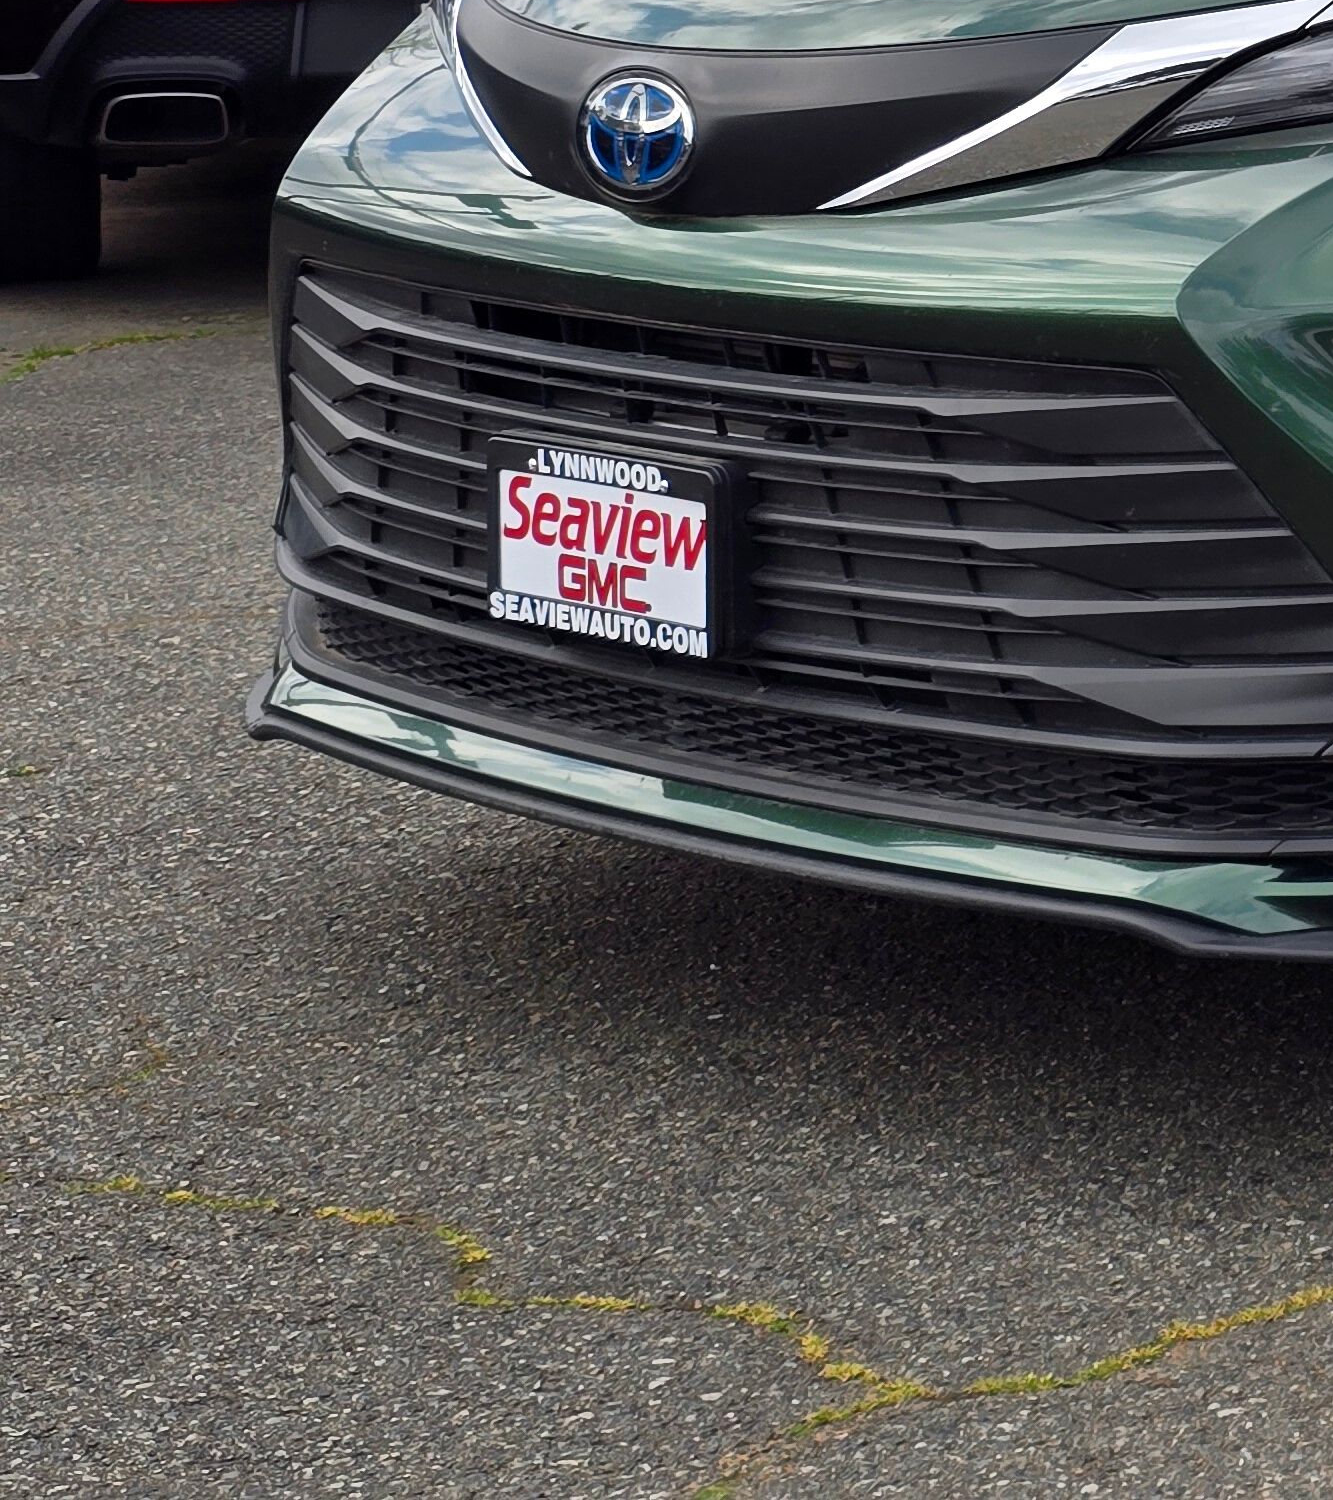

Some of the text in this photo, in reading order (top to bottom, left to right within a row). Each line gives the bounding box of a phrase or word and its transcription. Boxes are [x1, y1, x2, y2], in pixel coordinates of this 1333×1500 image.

[537, 448, 662, 493] LYNNWOOD
[503, 475, 708, 571] Seaview
[557, 553, 649, 615] GMC
[489, 590, 708, 659] SEAVIEWAUTO.COM
